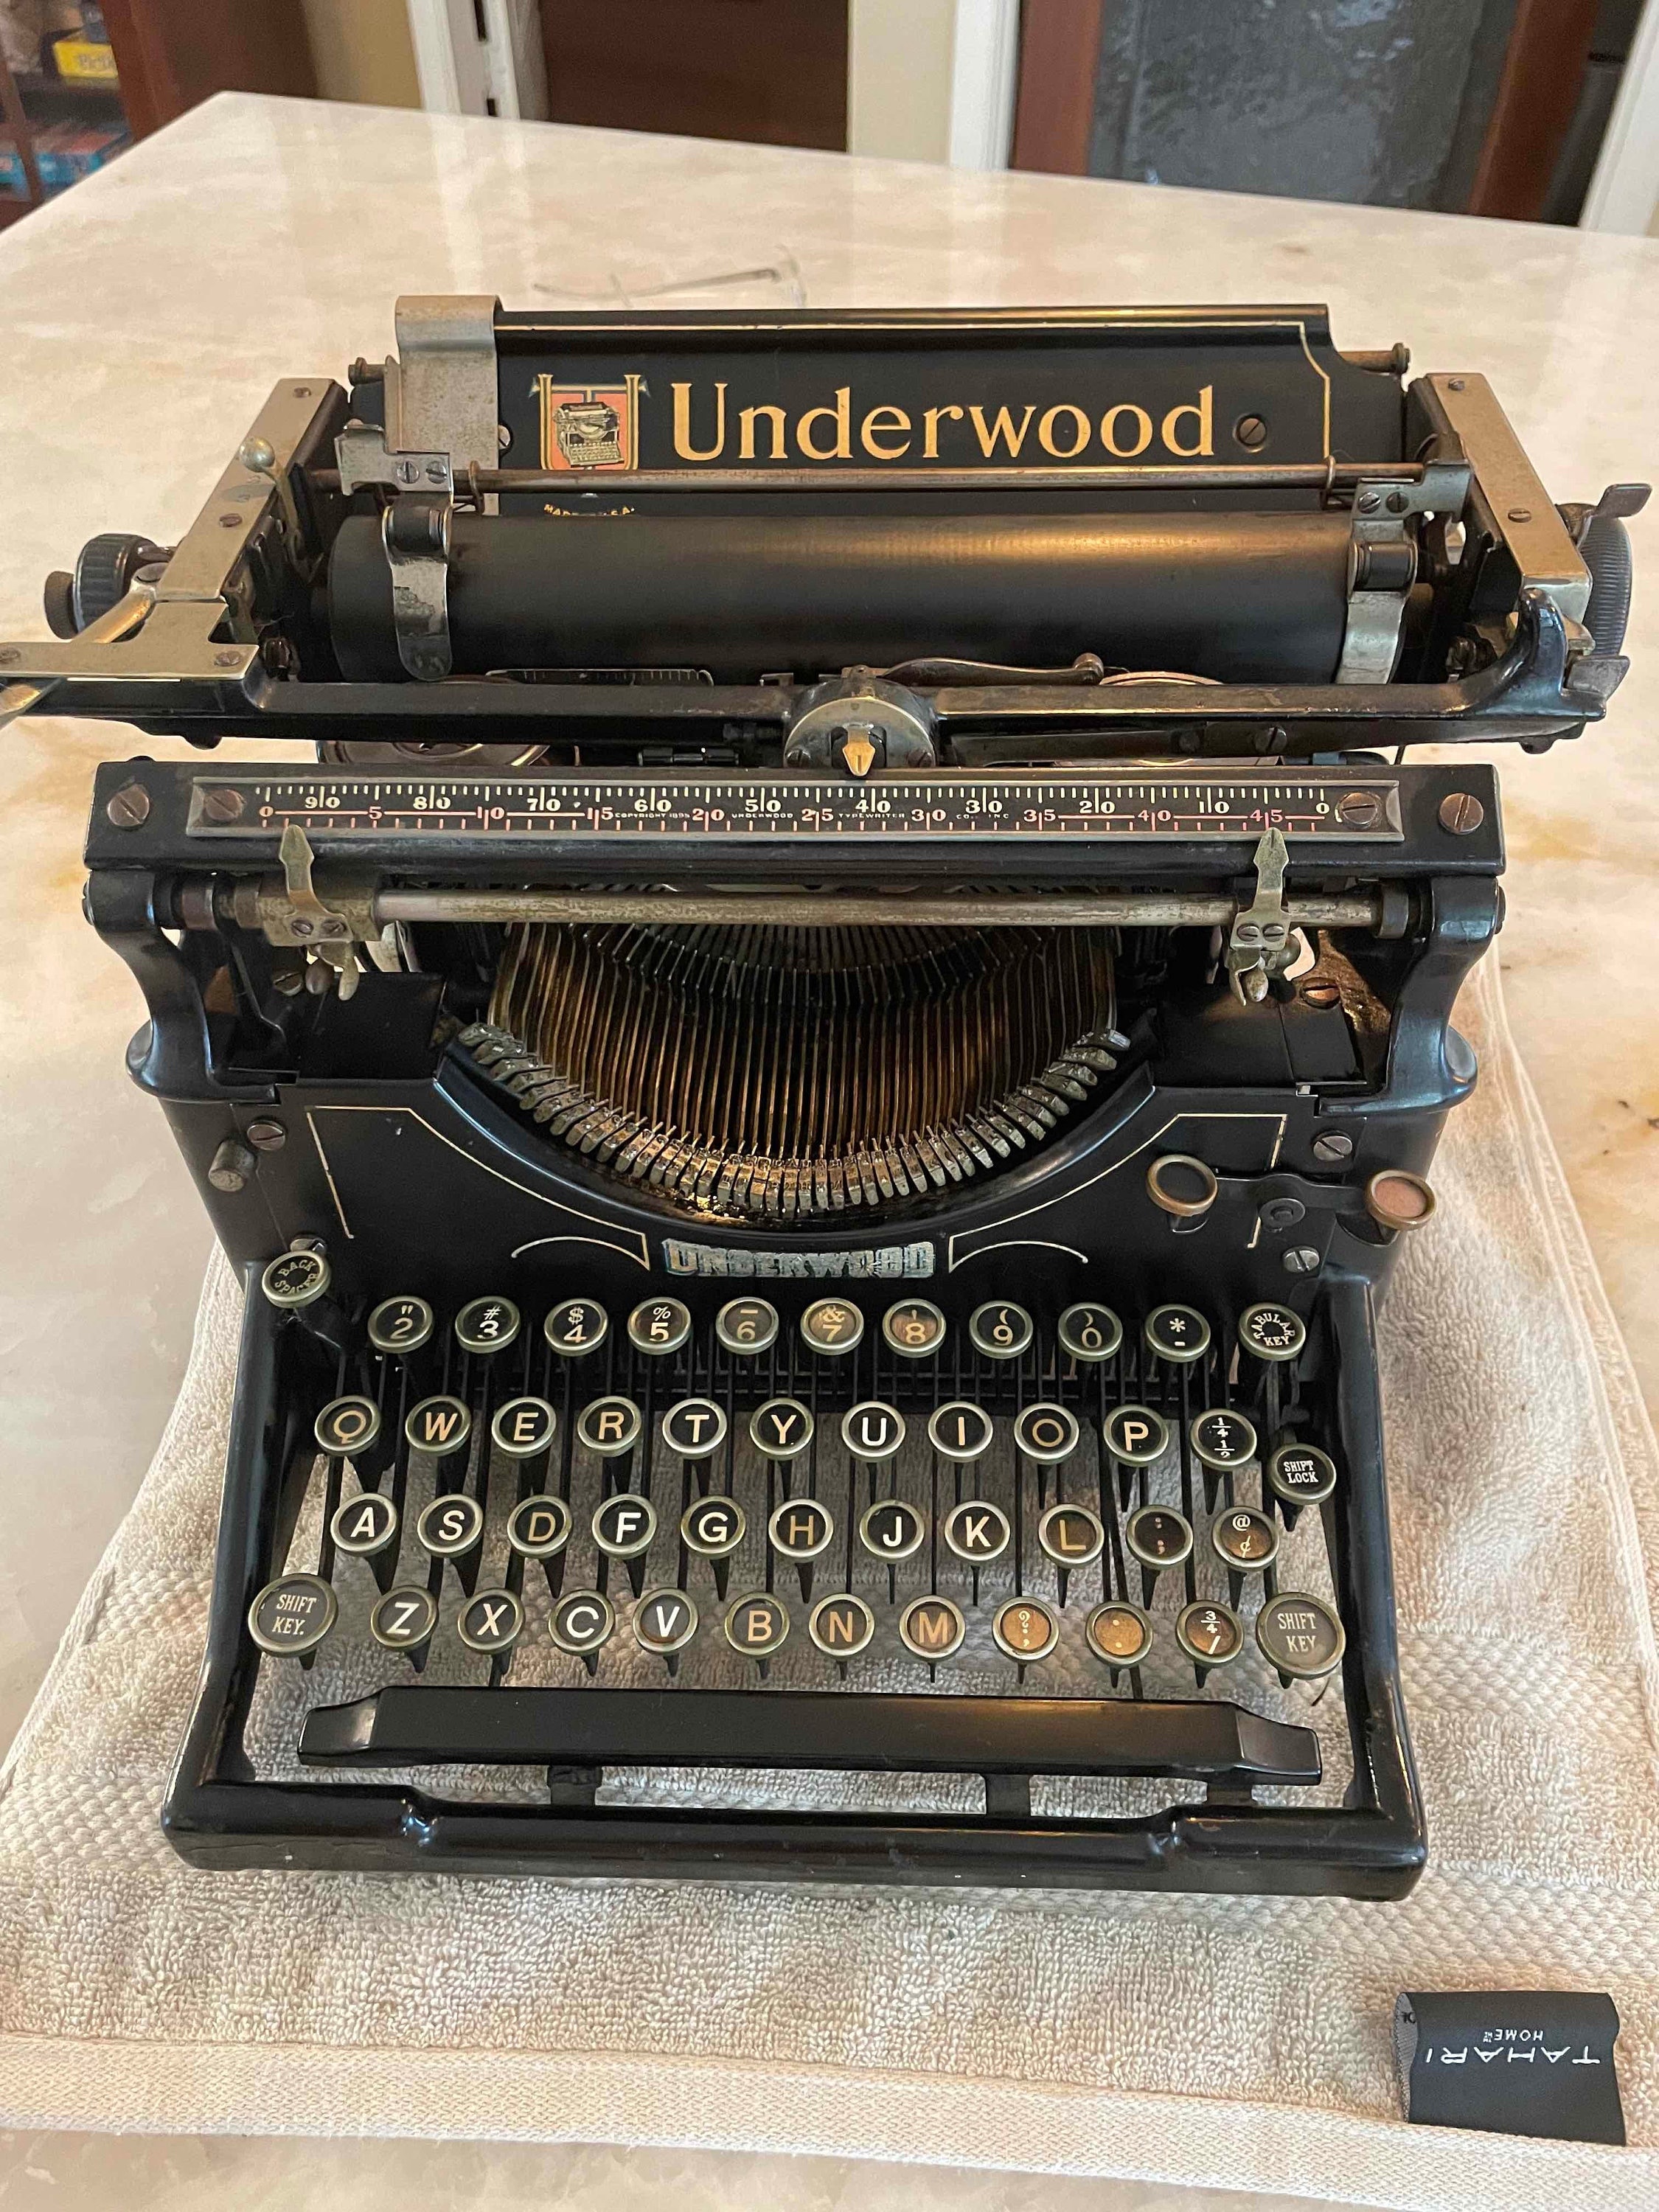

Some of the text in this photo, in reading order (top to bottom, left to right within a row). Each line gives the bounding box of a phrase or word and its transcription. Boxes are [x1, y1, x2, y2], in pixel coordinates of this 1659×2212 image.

[672, 382, 1215, 461] Underwood
[259, 805, 274, 817] 0
[369, 807, 383, 820] 5
[692, 808, 725, 821] 20
[801, 808, 835, 821] 25
[911, 809, 947, 821] 30
[1023, 809, 1057, 821] 35
[1138, 810, 1172, 822] 40
[1250, 810, 1284, 823] 45
[305, 796, 1330, 814] 90 80 70 60 50 40 30 20 10 0
[277, 1259, 317, 1277] BACK
[484, 1306, 501, 1321] #
[568, 1307, 585, 1325] $
[653, 1307, 672, 1322] %
[1251, 1312, 1295, 1340] TABULAR
[389, 1317, 414, 1340] 2
[477, 1320, 500, 1340] 3
[563, 1324, 588, 1344] 4
[649, 1322, 669, 1343] 5
[737, 1321, 756, 1340] 6
[822, 1324, 843, 1343] 7
[905, 1322, 926, 1345] 8
[993, 1325, 1013, 1346] 9
[1263, 1335, 1290, 1346] KEY
[333, 1410, 366, 1444] Q
[425, 1412, 458, 1441] W
[514, 1412, 539, 1441] E
[598, 1411, 625, 1440] R
[685, 1414, 710, 1444] T
[771, 1414, 797, 1444] Y
[861, 1416, 887, 1446] U
[958, 1416, 967, 1446] I
[1032, 1418, 1064, 1447] O
[1123, 1421, 1149, 1451] P
[1283, 1460, 1314, 1472] SHIFT
[1287, 1471, 1319, 1484] LOCK
[350, 1506, 375, 1538] A
[438, 1510, 465, 1541] S
[528, 1512, 556, 1543] D
[615, 1512, 642, 1543] F
[698, 1512, 728, 1543] G
[789, 1514, 814, 1545] H
[883, 1516, 903, 1547] J
[964, 1515, 992, 1548] K
[1059, 1520, 1087, 1551] L
[1231, 1514, 1251, 1532] @
[276, 1593, 317, 1613] SHIFT
[271, 1615, 305, 1635] KEY.
[386, 1602, 420, 1635] Z
[476, 1603, 508, 1636] X
[566, 1606, 599, 1638] C
[655, 1605, 681, 1638] V
[747, 1610, 773, 1642] B
[829, 1610, 854, 1643] N
[918, 1612, 949, 1644] M
[1018, 1610, 1031, 1634] ?
[1277, 1613, 1317, 1630] SHIFT
[1286, 1635, 1316, 1652] KEY
[1493, 2028, 1544, 2042] HOME
[1425, 2045, 1601, 2065] TAHARI
